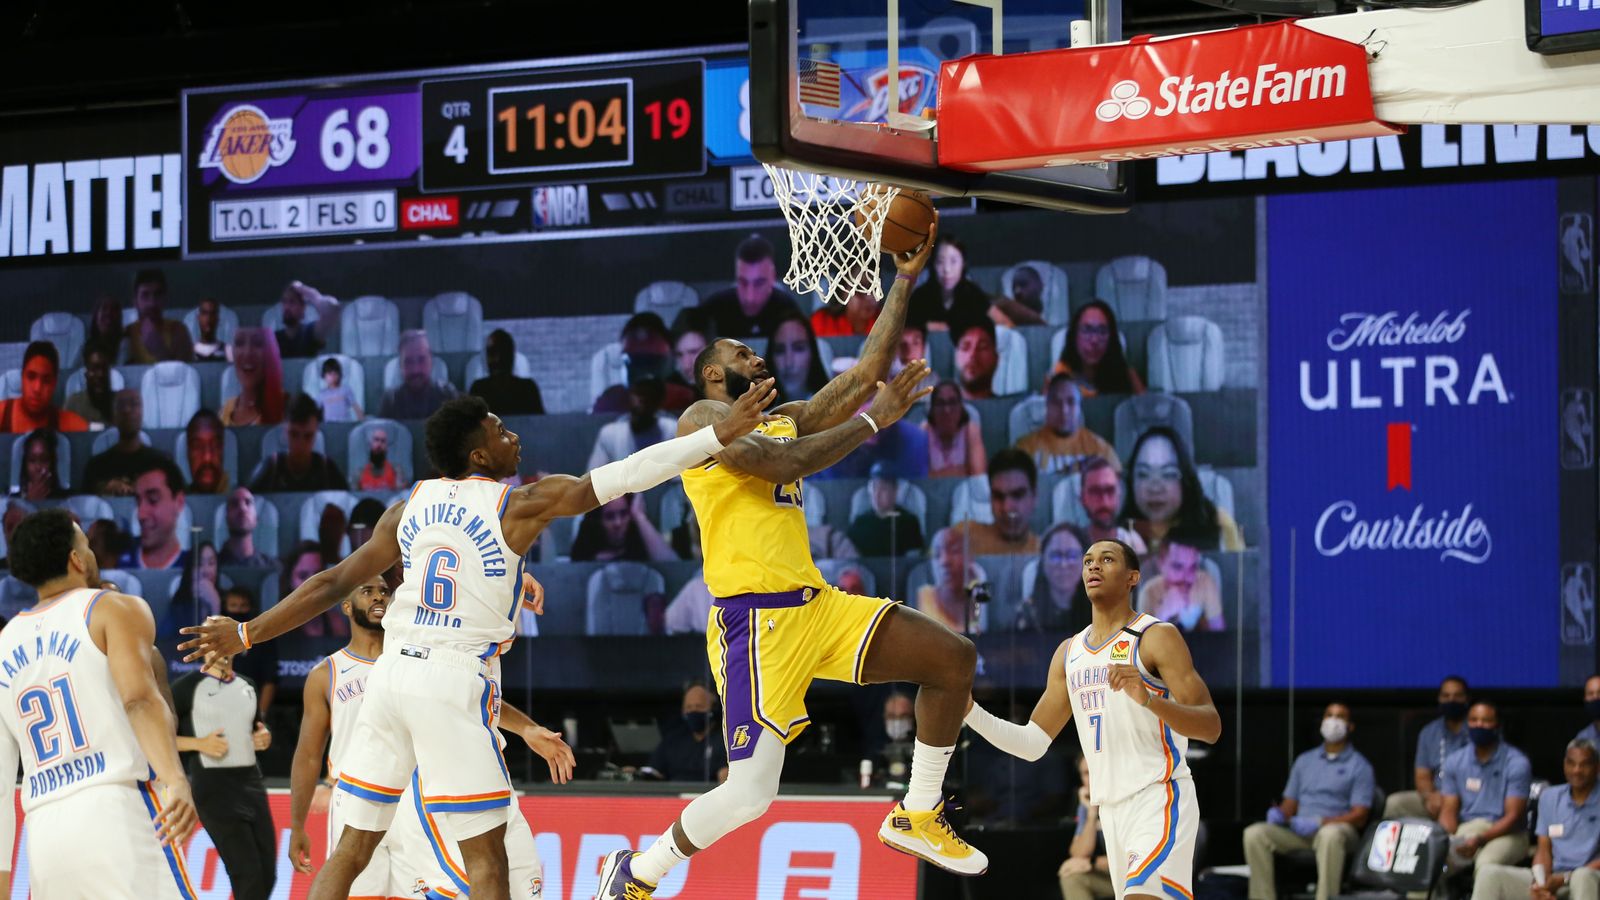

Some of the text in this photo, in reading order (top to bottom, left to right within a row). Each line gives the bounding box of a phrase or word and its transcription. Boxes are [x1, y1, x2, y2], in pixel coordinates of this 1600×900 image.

[441, 101, 471, 119] QTR
[498, 98, 625, 152] 11:04
[645, 98, 691, 140] 19
[320, 106, 390, 171] 68
[443, 124, 468, 164] 4
[220, 200, 386, 231] T.O.L. 2 FLS 0
[407, 203, 452, 222] CHAL
[548, 185, 590, 226] NBA
[1327, 309, 1471, 351] Michelob
[1300, 353, 1509, 411] ULTRA
[399, 503, 507, 577] BLACK LIVES MATTER
[1314, 500, 1492, 564] Courtside
[421, 547, 460, 612] 6
[2, 644, 30, 679] AM
[36, 636, 43, 660] A
[48, 630, 81, 663] MAN
[1070, 666, 1109, 694] KLAHO
[1080, 688, 1106, 711] CITY
[17, 672, 90, 767] 21
[1088, 713, 1102, 752] 7
[29, 751, 106, 799] ROBERSON
